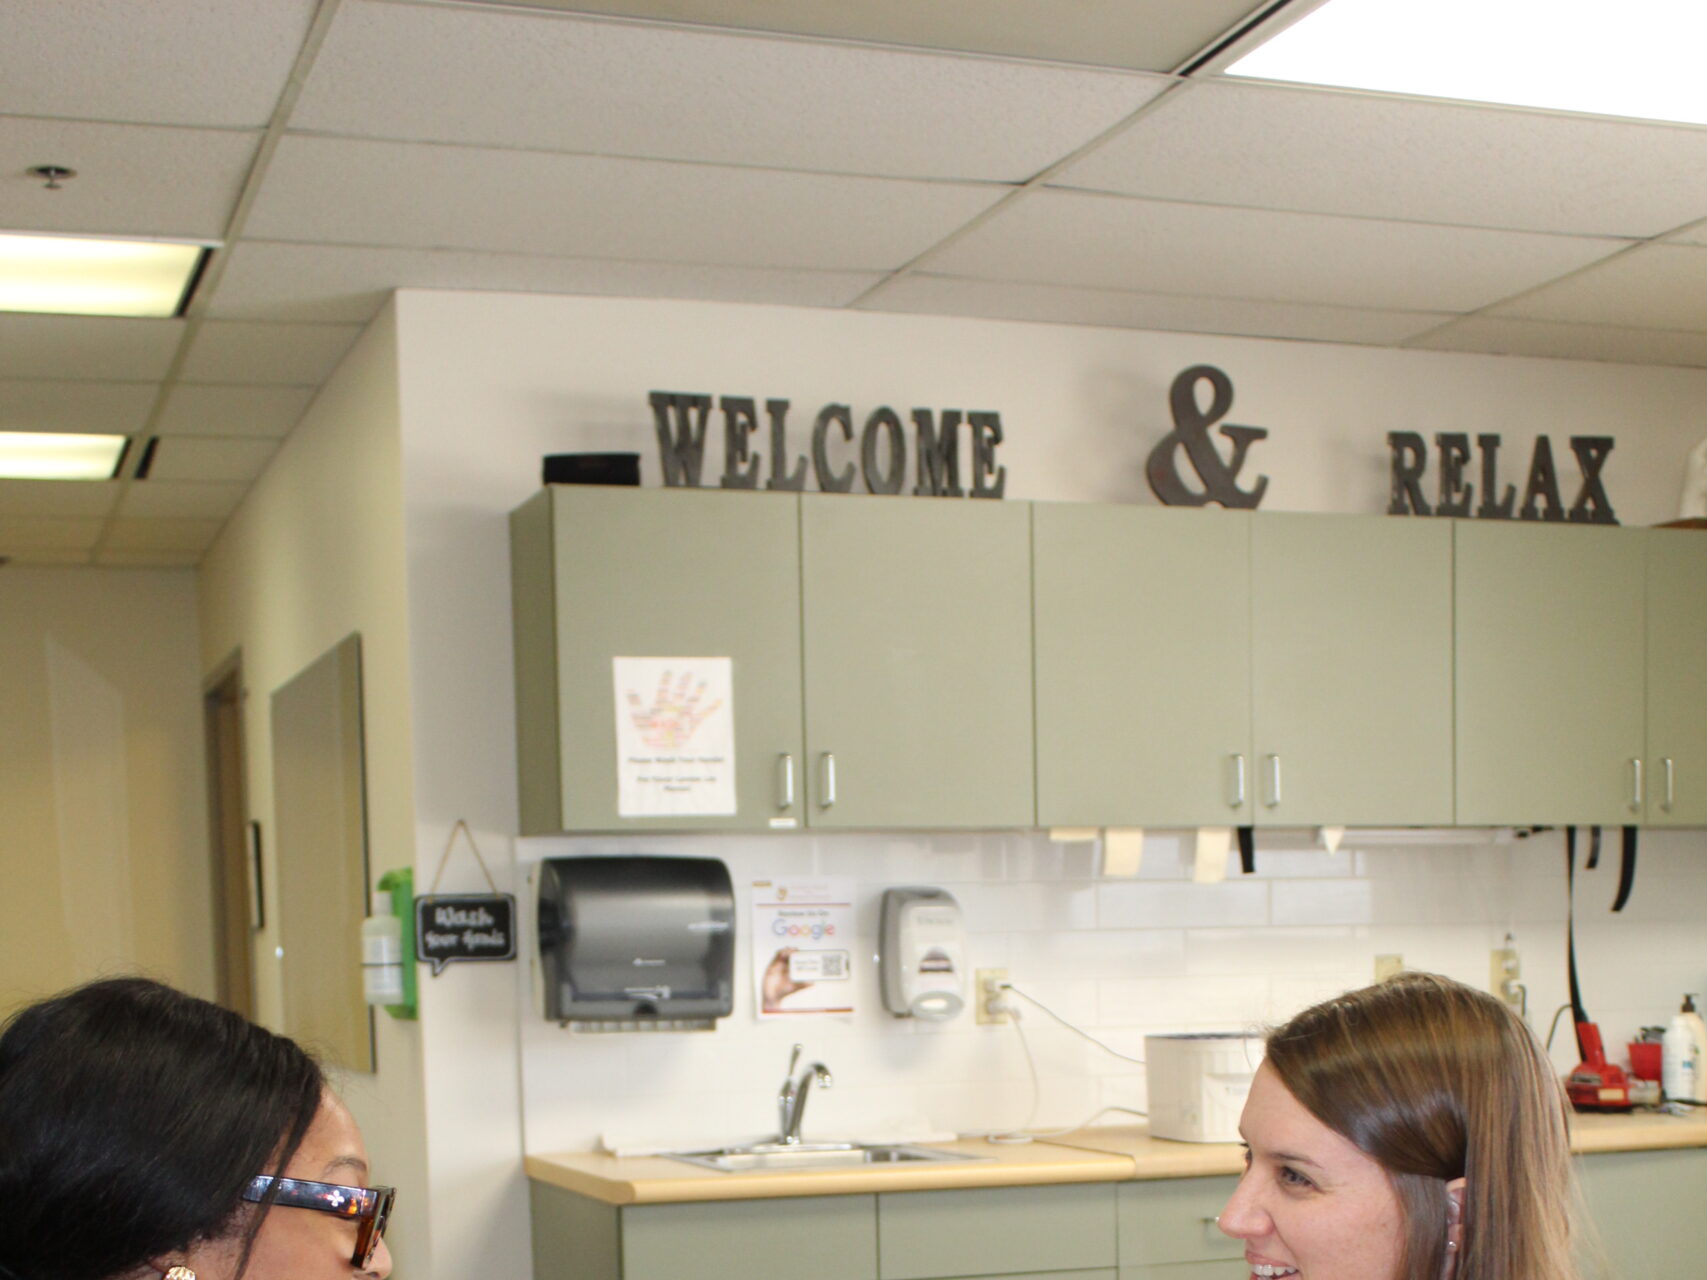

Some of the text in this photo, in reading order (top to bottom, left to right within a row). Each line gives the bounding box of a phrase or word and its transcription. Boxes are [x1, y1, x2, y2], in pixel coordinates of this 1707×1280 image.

[648, 364, 1621, 526] WELCOME & RELAX
[771, 918, 836, 940] Google
